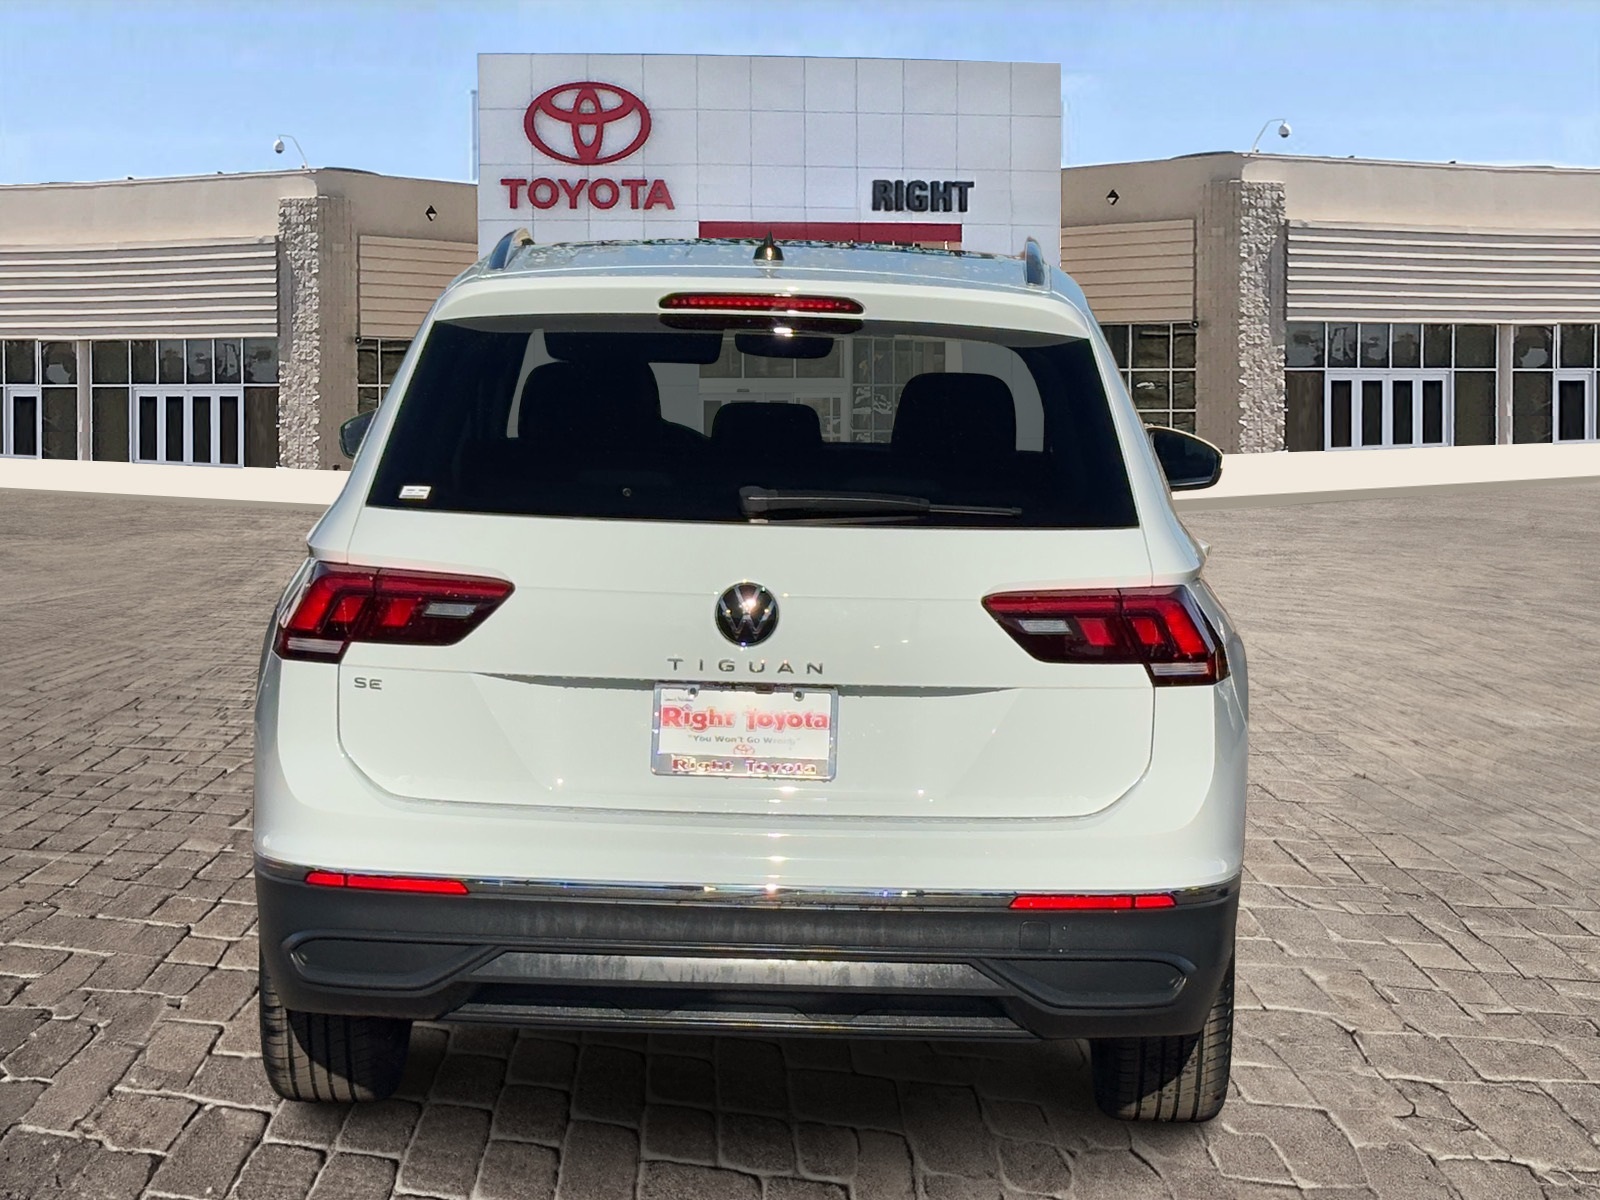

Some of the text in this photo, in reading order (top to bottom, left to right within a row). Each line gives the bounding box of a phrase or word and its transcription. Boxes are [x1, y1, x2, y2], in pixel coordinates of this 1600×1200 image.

[501, 178, 675, 210] TOYOTA
[872, 179, 975, 213] RIGHT
[716, 583, 778, 643] VW
[667, 658, 824, 675] TIGUAN
[353, 676, 383, 691] SE
[661, 706, 830, 732] Right Toyota
[746, 736, 760, 745] Go
[671, 757, 817, 775] Right Toyota
